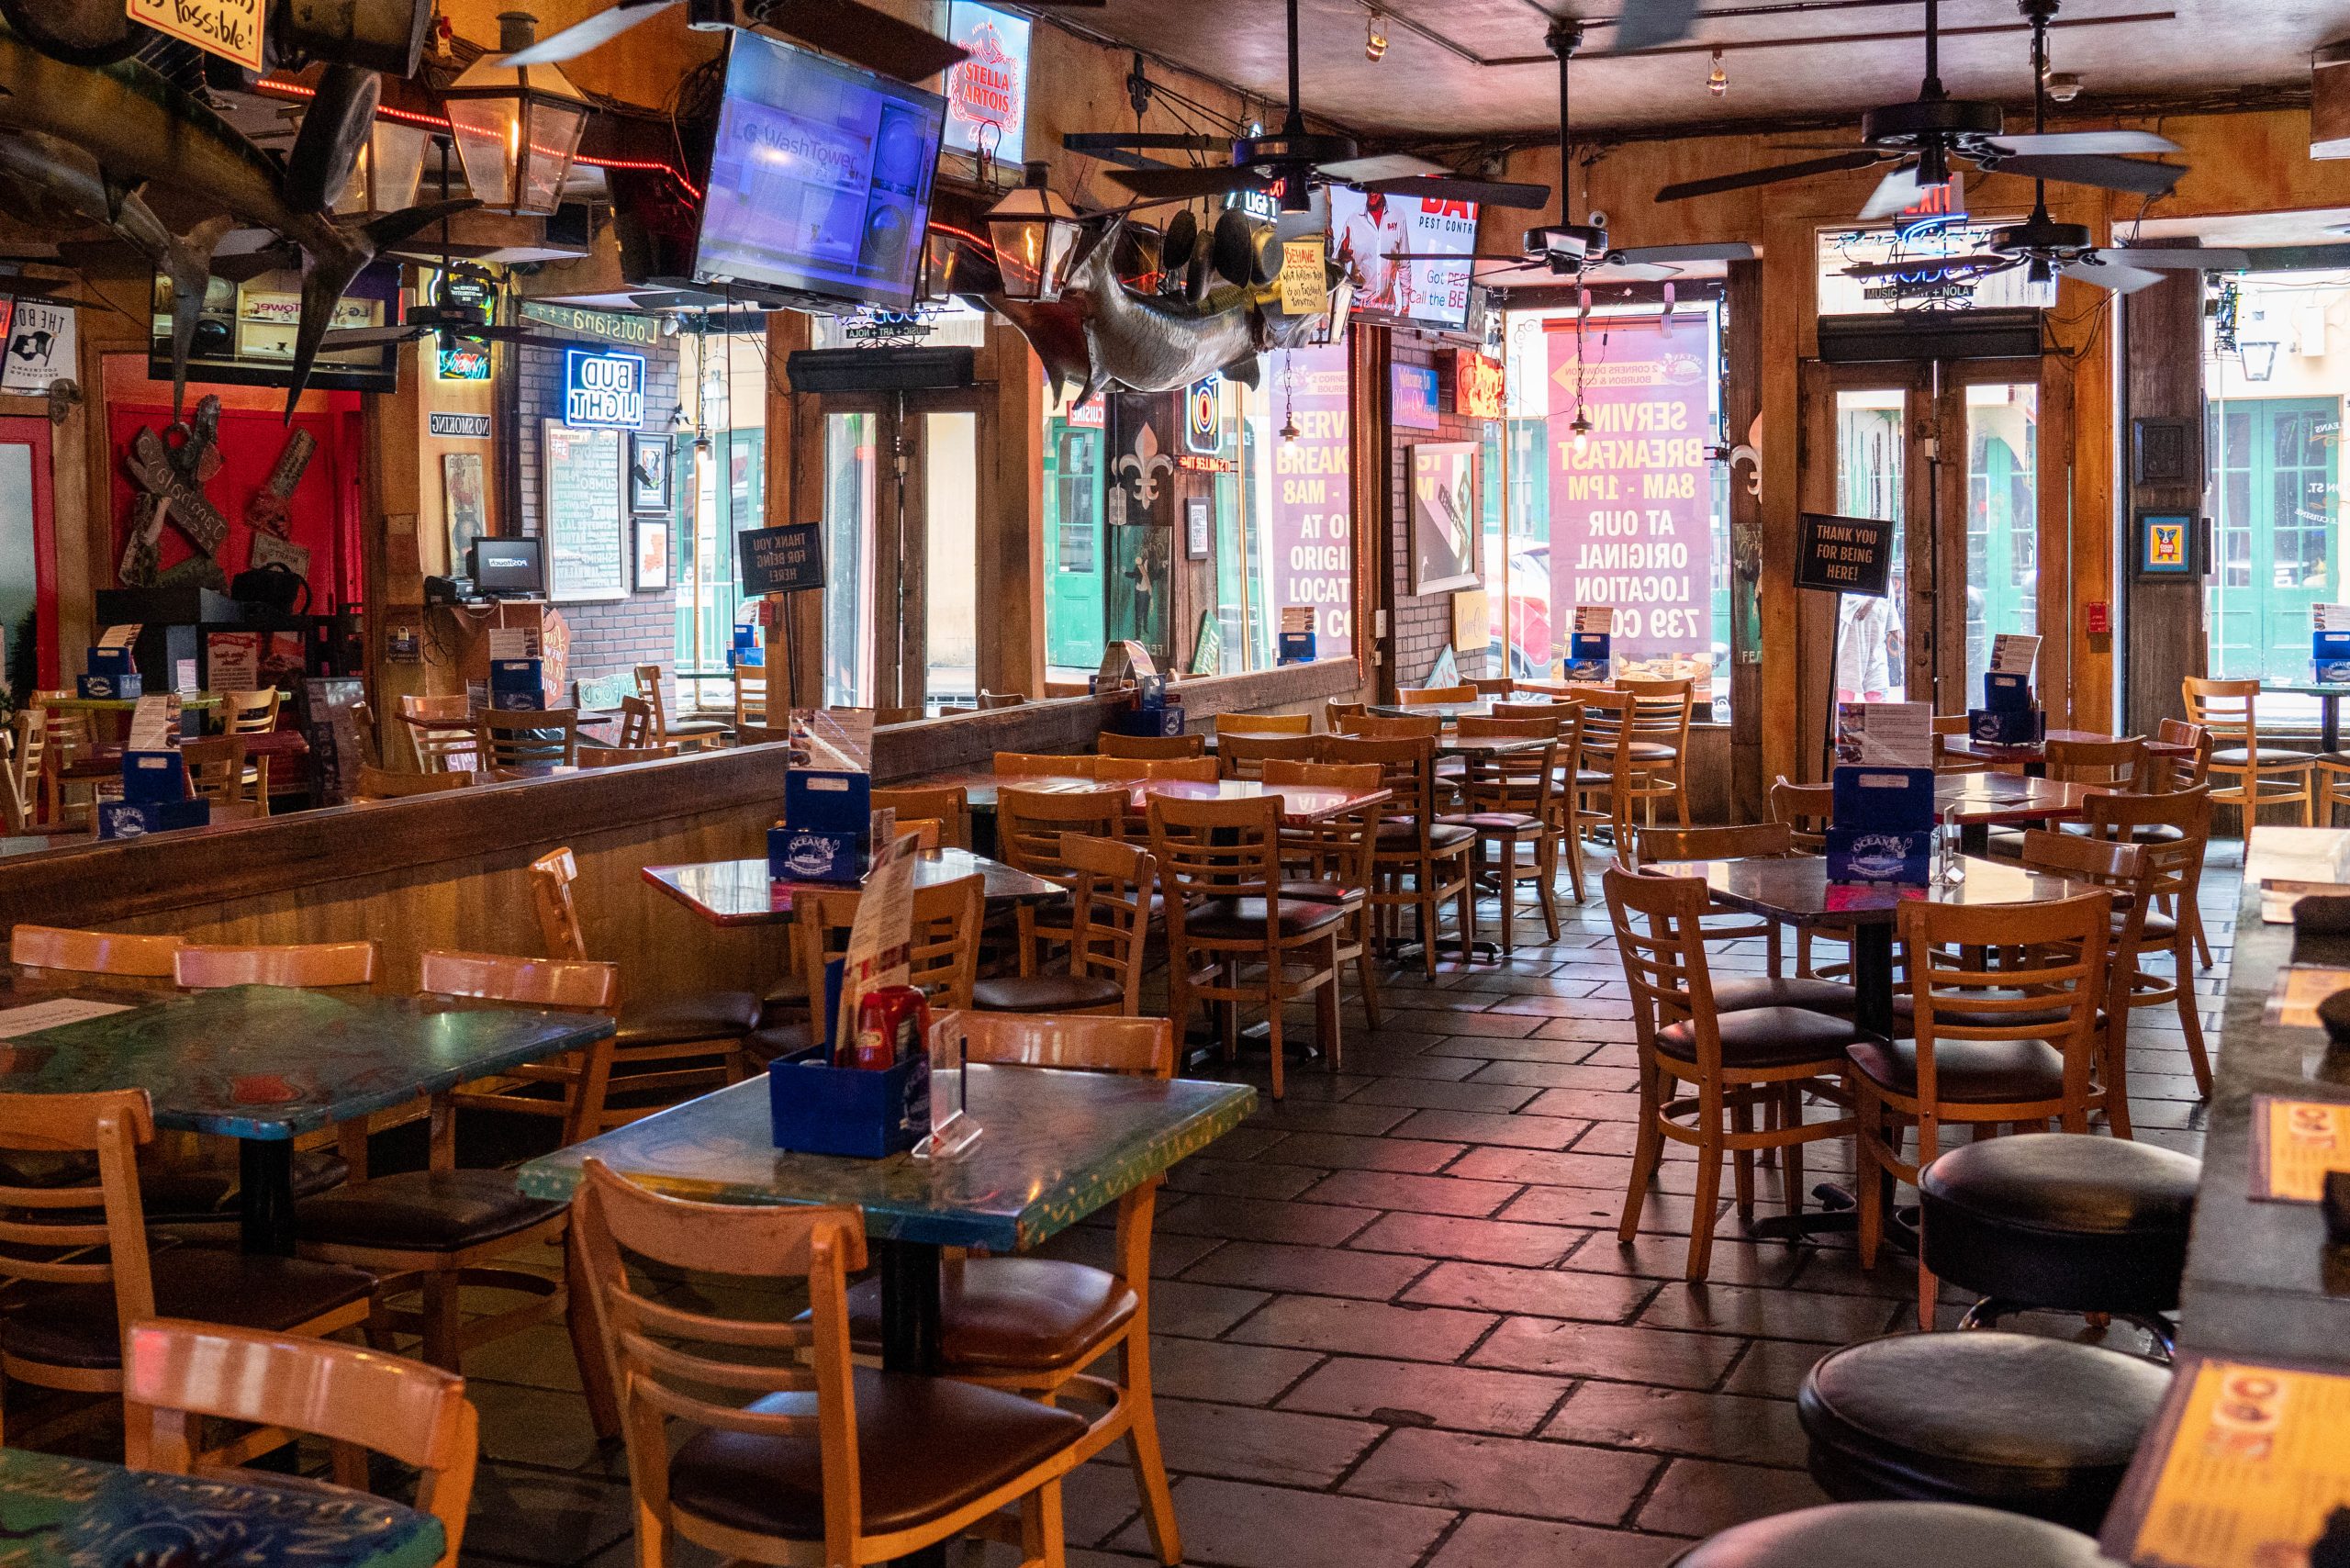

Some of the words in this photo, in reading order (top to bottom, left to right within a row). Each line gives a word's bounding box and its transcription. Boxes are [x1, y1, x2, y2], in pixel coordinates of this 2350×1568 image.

[965, 62, 1010, 92] STELLA
[962, 84, 1010, 114] ARTOIS
[1905, 174, 1953, 214] XIT
[1387, 222, 1398, 230] BAY
[1419, 216, 1441, 230] PEST
[1284, 246, 1315, 263] BEHAVE
[1427, 270, 1445, 286] Got
[1409, 289, 1427, 305] Call
[1429, 292, 1446, 307] the
[1448, 290, 1467, 308] BE
[1866, 287, 1898, 299] MUSIC
[1942, 286, 1970, 297] NOLA
[1398, 367, 1422, 387] Welcome
[1423, 370, 1431, 390] to
[1283, 479, 1326, 505] 8AM
[1300, 514, 1324, 539] AT
[1817, 524, 1853, 543] THANK
[1855, 529, 1877, 544] YOU
[1290, 545, 1350, 571] ORIGI
[1817, 543, 1837, 560] FOR
[1840, 546, 1873, 564] BEING
[1827, 564, 1859, 581] HERE!
[789, 837, 821, 850] OCEAN
[1853, 837, 1891, 853] OCEAN
